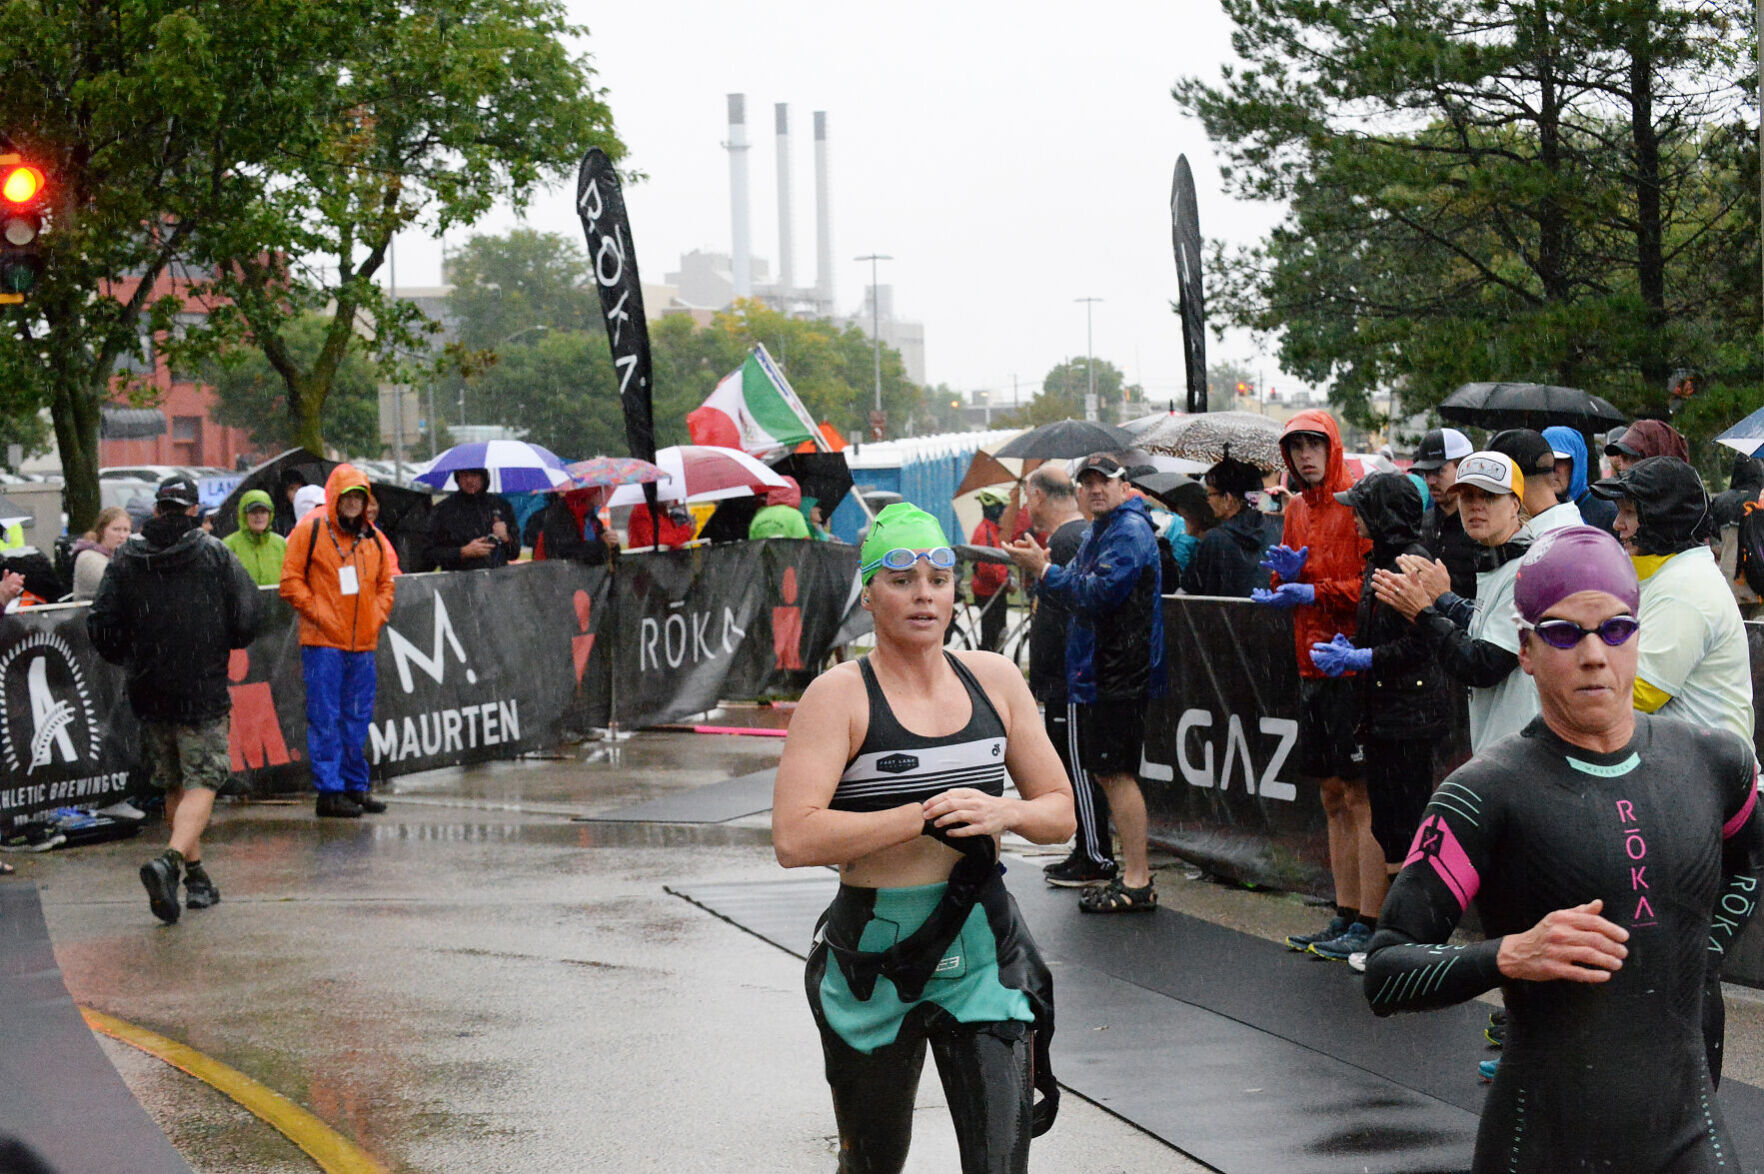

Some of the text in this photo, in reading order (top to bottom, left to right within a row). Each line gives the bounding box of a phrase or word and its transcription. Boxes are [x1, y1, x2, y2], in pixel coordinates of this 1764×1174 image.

[368, 699, 521, 765] MAURTEN
[0, 783, 46, 809] HLETIC
[49, 775, 110, 800] BREWING
